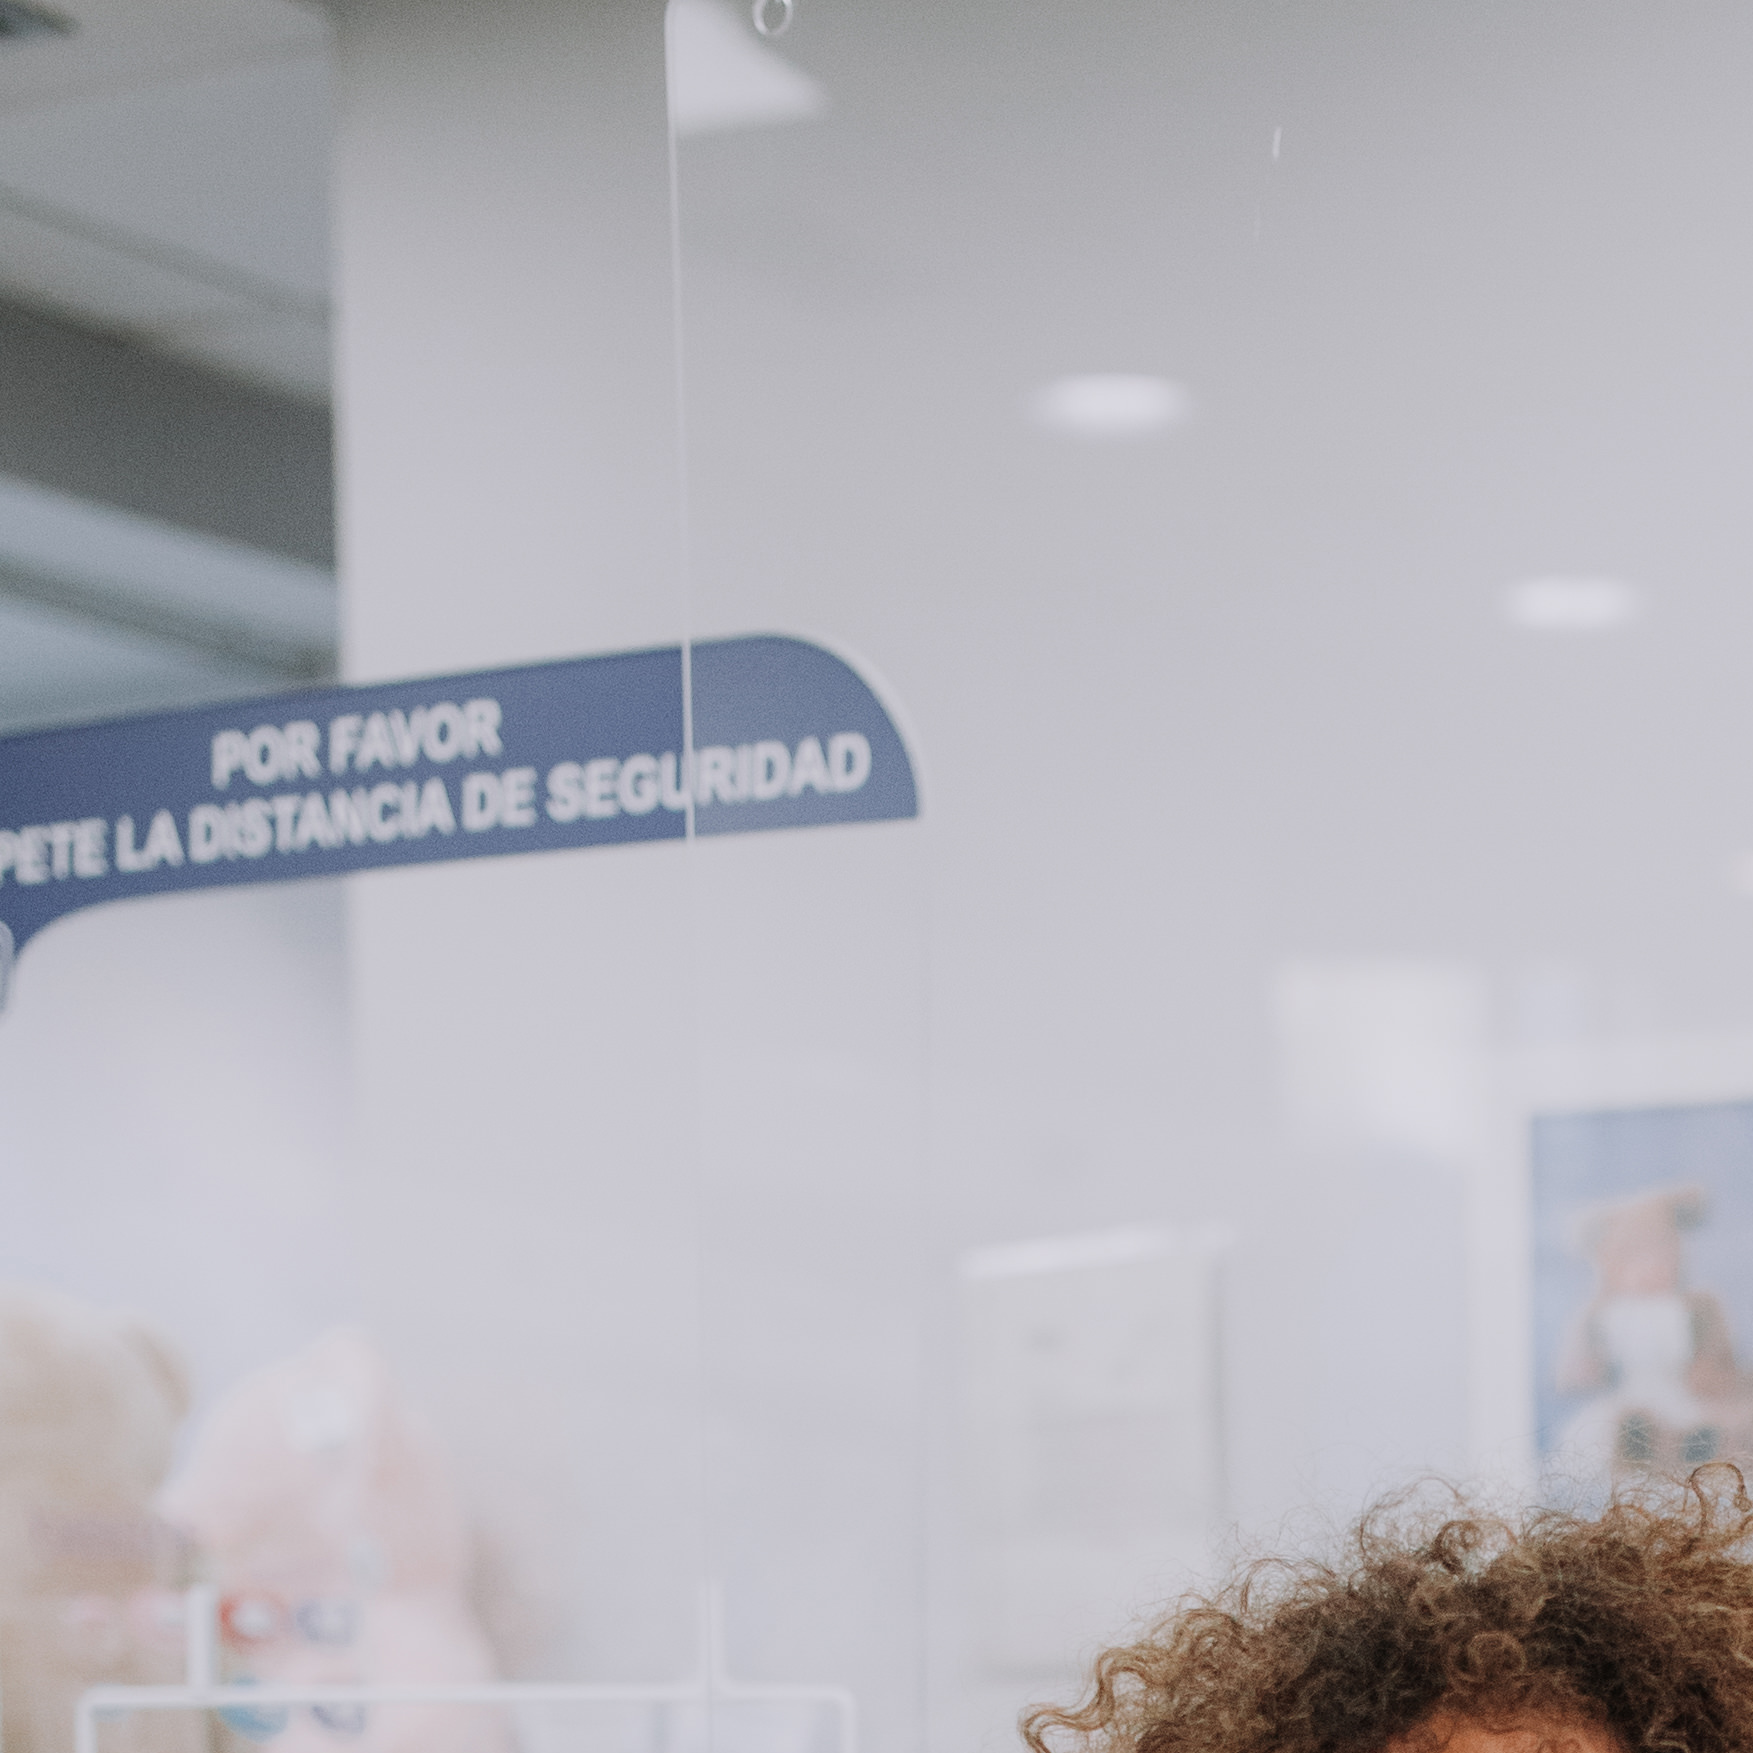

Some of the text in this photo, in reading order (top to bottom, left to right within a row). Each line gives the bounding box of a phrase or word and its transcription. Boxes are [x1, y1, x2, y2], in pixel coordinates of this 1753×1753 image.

[115, 808, 185, 873] LA
[188, 775, 457, 865] DISTANCIA
[461, 766, 538, 833] DE
[546, 731, 873, 825] SEGURIDAD
[210, 697, 503, 790] POR FAVOR
